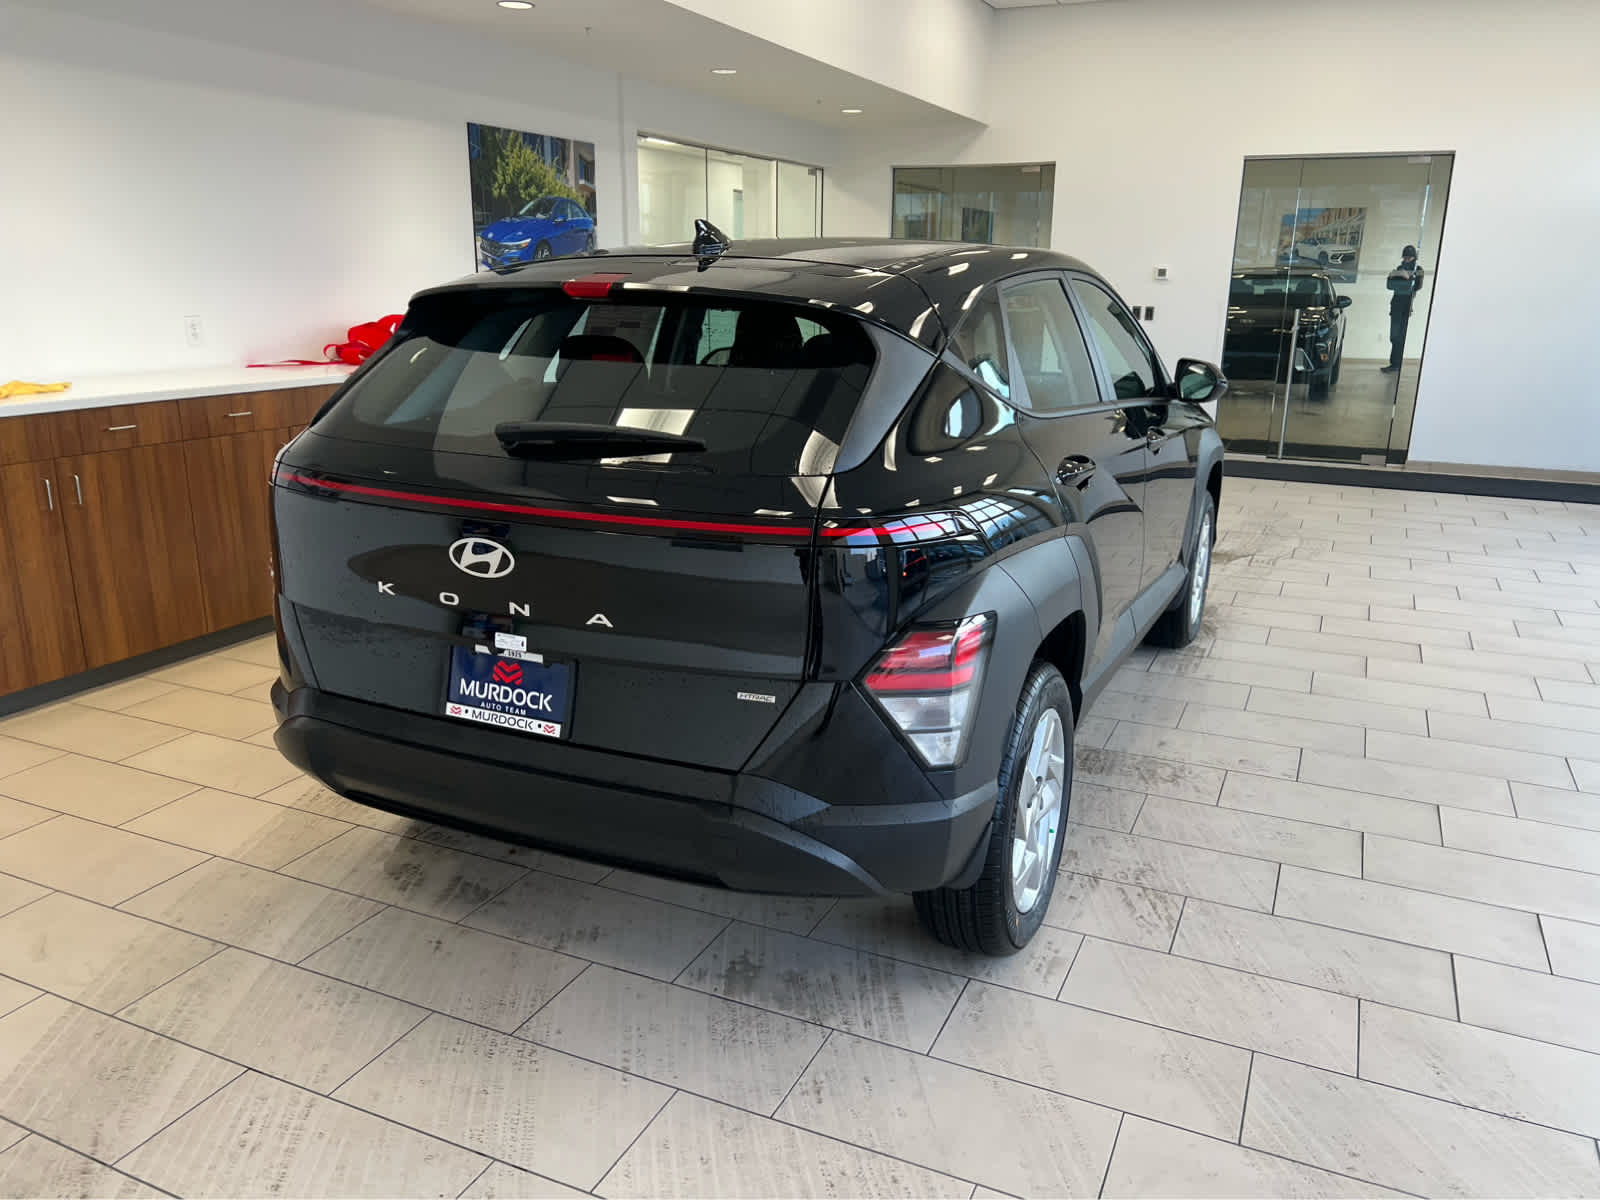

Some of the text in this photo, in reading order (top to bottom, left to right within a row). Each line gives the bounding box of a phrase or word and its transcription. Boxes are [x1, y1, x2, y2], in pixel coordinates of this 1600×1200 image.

[377, 581, 614, 628] KONA
[460, 678, 552, 712] MURDOCK
[480, 701, 527, 716] AUTO TEAM
[471, 709, 534, 730] MURDOCK
